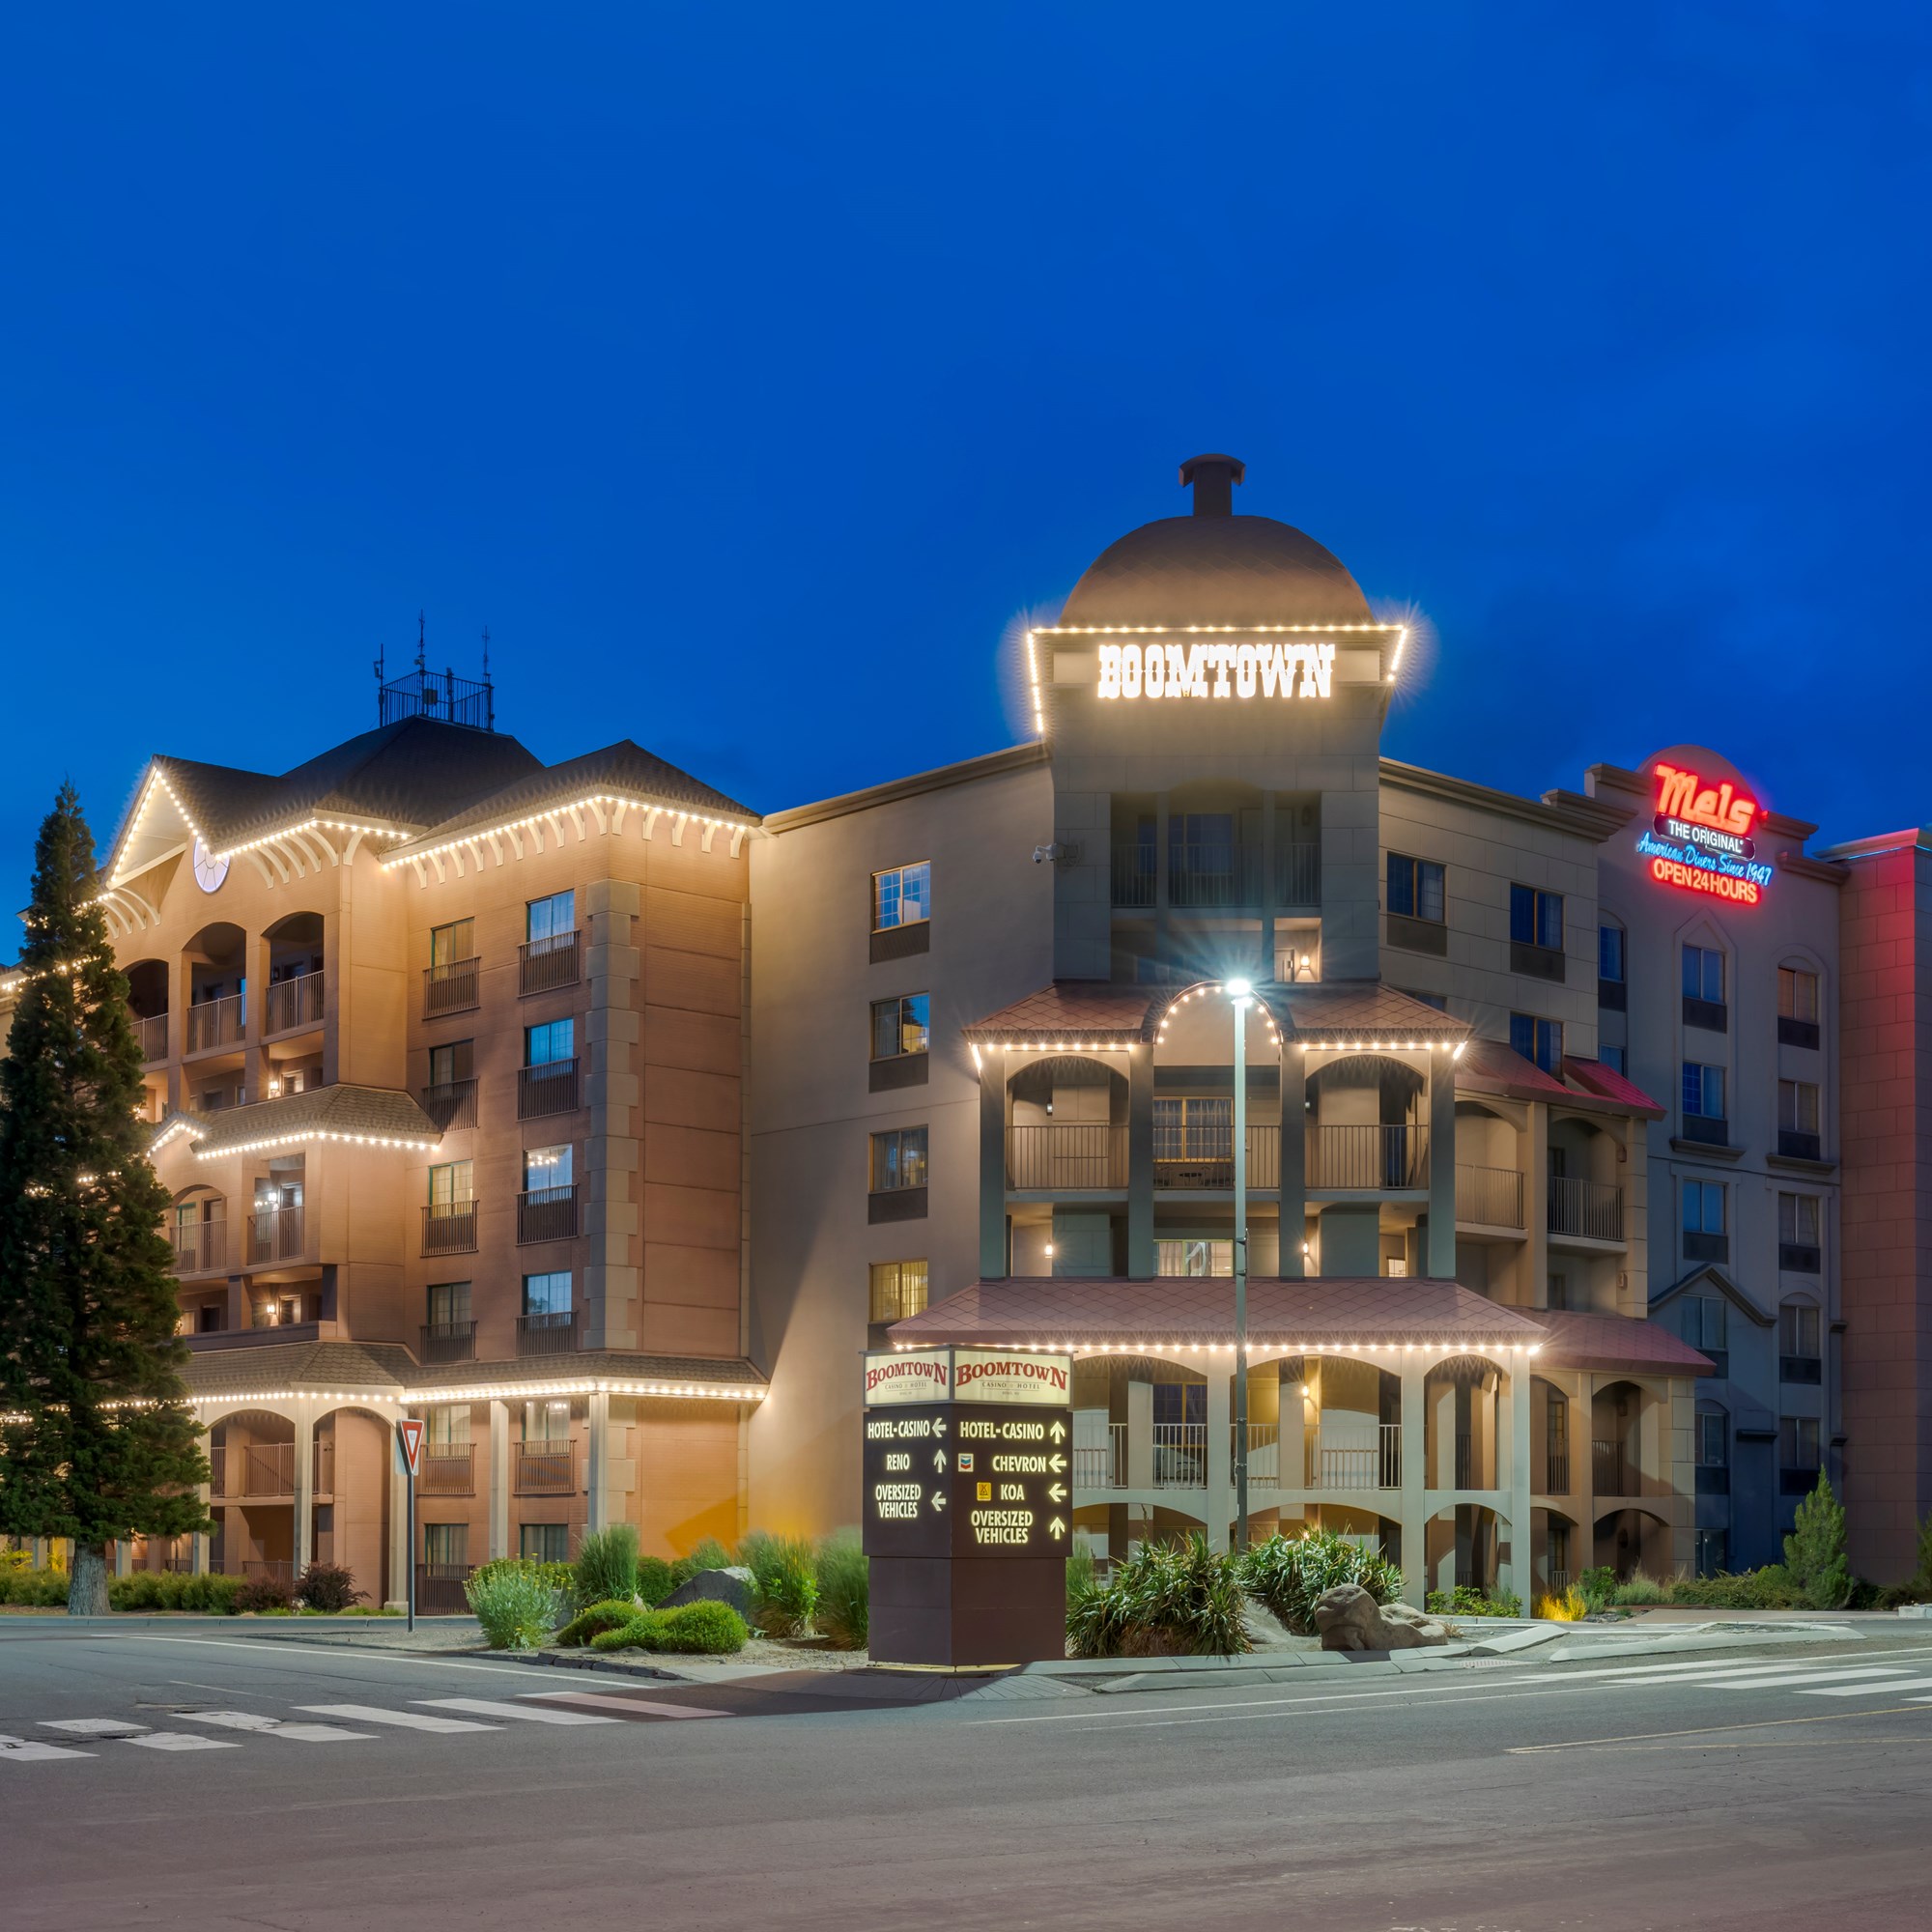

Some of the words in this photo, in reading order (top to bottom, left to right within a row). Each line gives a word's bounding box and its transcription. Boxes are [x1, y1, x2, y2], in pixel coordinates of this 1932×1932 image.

[1097, 643, 1336, 698] BOOMTOWN
[1655, 764, 1756, 835] Mels
[1668, 820, 1690, 839] THE
[1691, 827, 1744, 853] ORIGINAL
[1638, 832, 1684, 863] American
[1684, 844, 1718, 871] Diners
[1718, 853, 1745, 878] Since
[1746, 862, 1774, 887] 1947
[1653, 858, 1691, 888] OPEN
[1692, 869, 1710, 891] 24
[1710, 872, 1758, 904] HOURS
[866, 1361, 948, 1391] BOOMTOWN
[955, 1361, 1068, 1390] BOOMTOWN
[867, 1420, 930, 1438] HOTEL-CASINO
[959, 1421, 1044, 1439] HOTEL-CASINO
[886, 1454, 910, 1470] RENO
[992, 1455, 1046, 1472] CHEVRON
[875, 1484, 922, 1501] OVERSIZED
[1000, 1484, 1025, 1500] KOA
[878, 1501, 918, 1519] VEHICLES
[971, 1510, 1034, 1527] OVERSIZED
[975, 1527, 1029, 1544] VEHICLES
